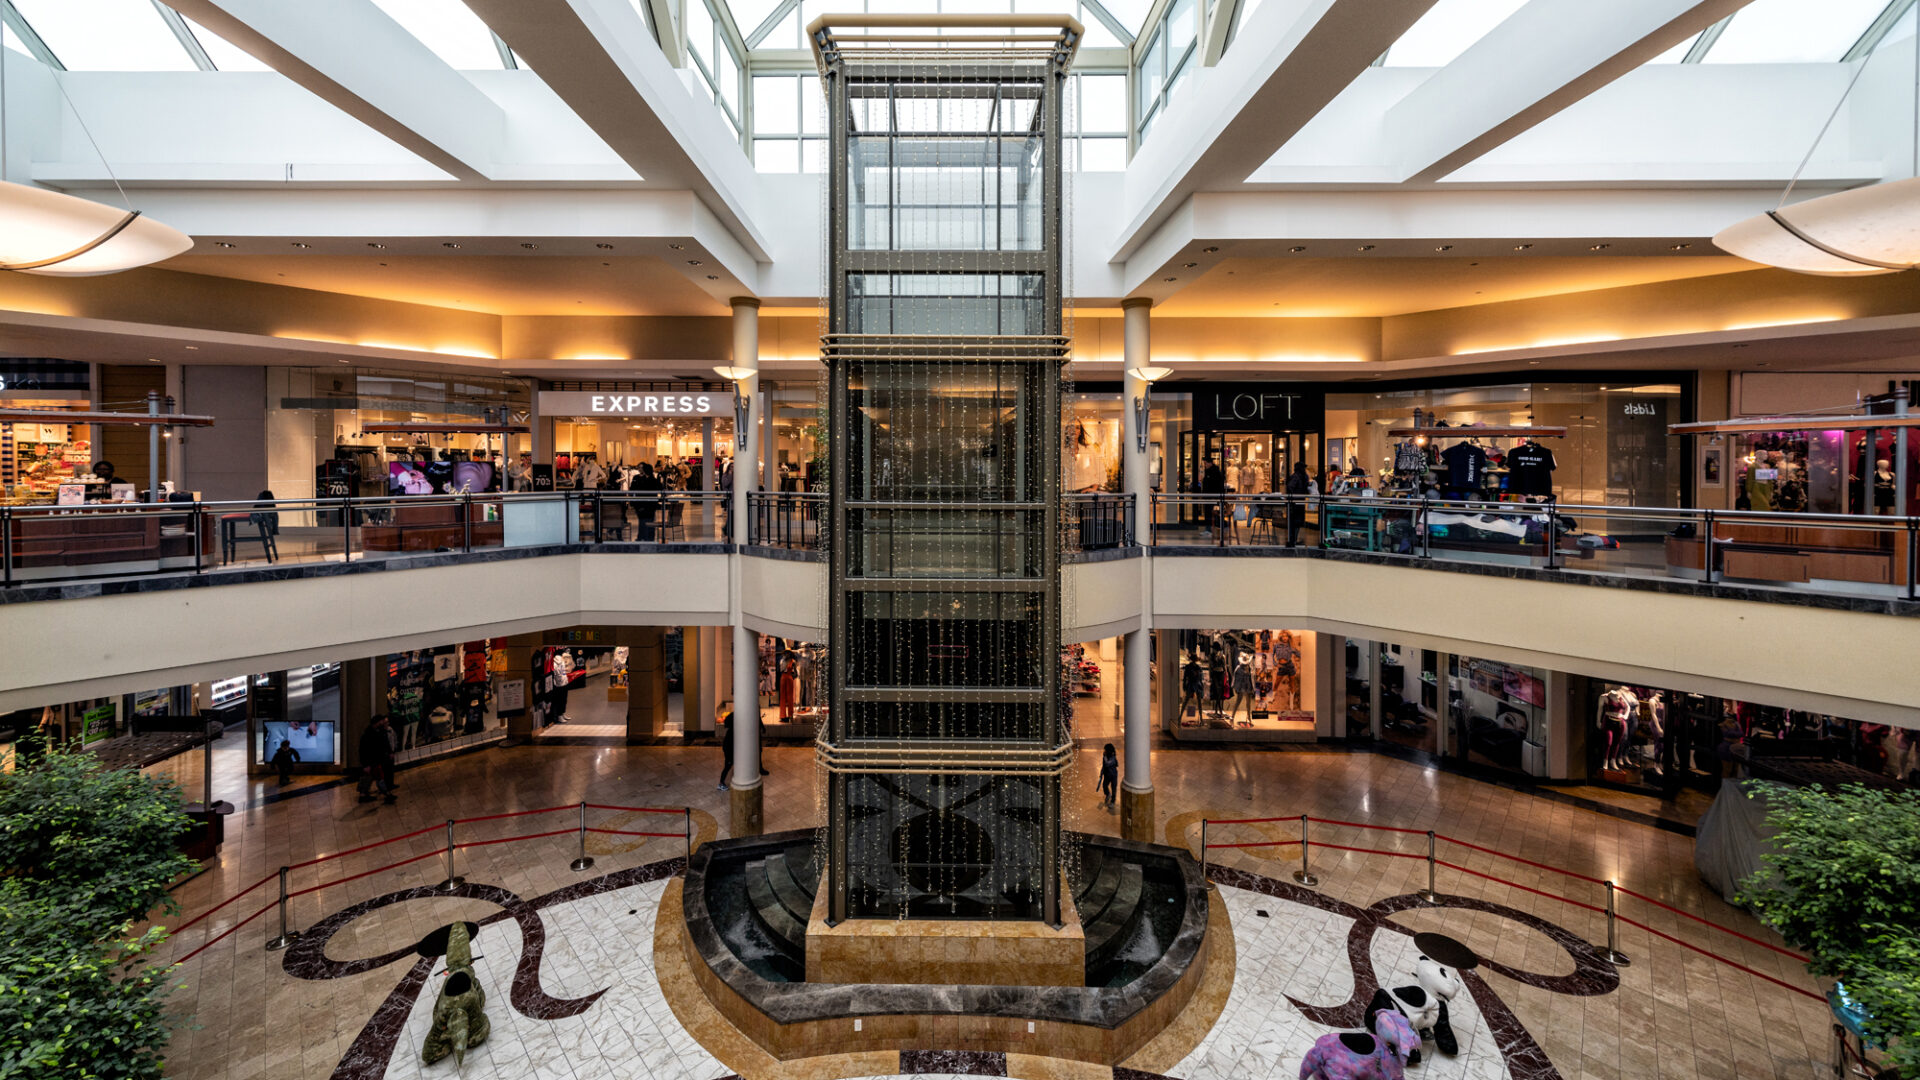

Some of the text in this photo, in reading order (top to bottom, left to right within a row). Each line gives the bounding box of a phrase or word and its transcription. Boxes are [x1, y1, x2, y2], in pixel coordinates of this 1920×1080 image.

[363, 401, 427, 412] EXPRESS
[591, 396, 710, 412] EXPRESS
[1216, 393, 1301, 420] LOFT
